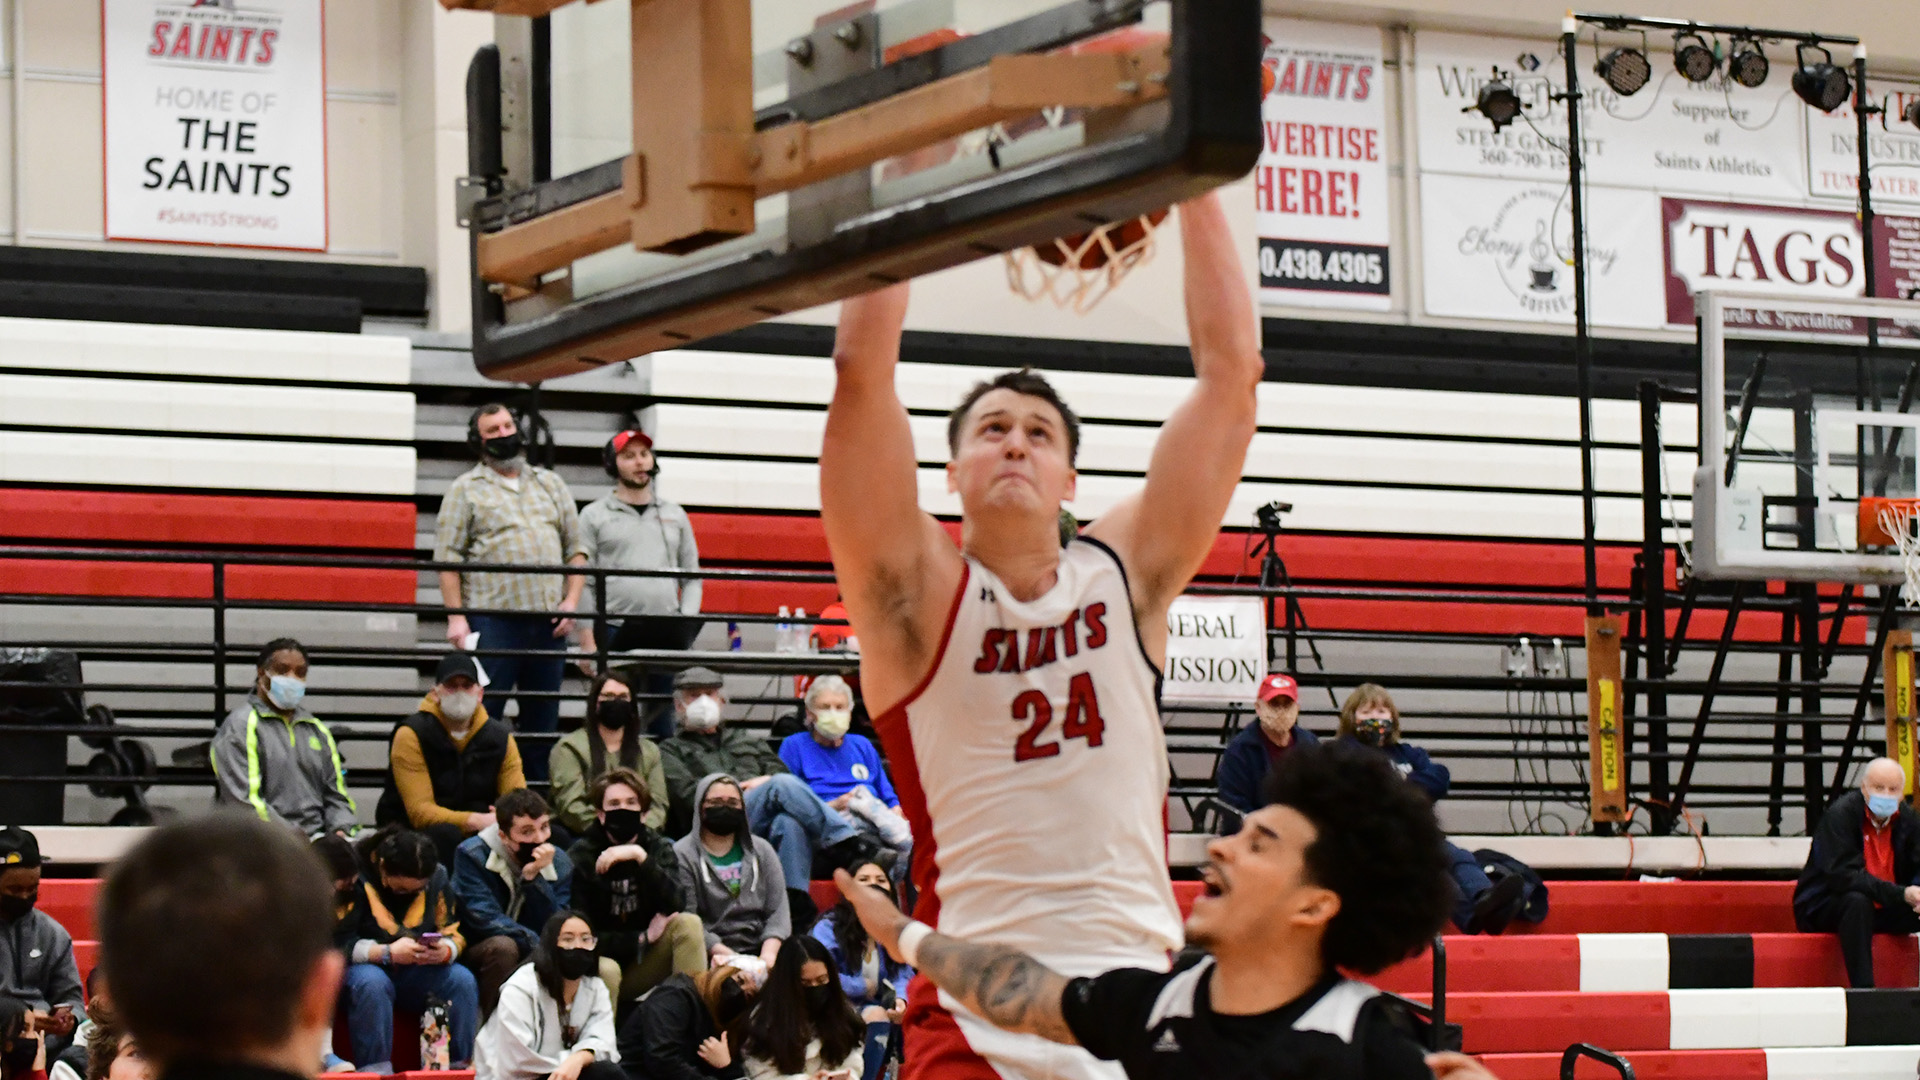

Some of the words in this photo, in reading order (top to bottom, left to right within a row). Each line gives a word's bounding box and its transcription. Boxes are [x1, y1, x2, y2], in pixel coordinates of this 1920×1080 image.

[149, 20, 278, 64] SAINTS
[155, 86, 233, 111] HOME
[241, 91, 276, 113] OF
[178, 117, 256, 153] THE
[1265, 121, 1378, 161] VERTISE
[1704, 130, 1720, 146] of
[143, 157, 291, 197] SAINTS
[1654, 151, 1700, 171] Saints
[1706, 155, 1771, 177] Athletics
[1256, 165, 1360, 219] HERE!
[1260, 245, 1383, 285] 0.438.4305
[1690, 221, 1854, 287] TAGS
[1755, 309, 1773, 326] &
[1775, 311, 1853, 331] Specialties
[1737, 513, 1746, 531] 2
[1168, 657, 1257, 684] ISSION
[1011, 671, 1106, 763] 24
